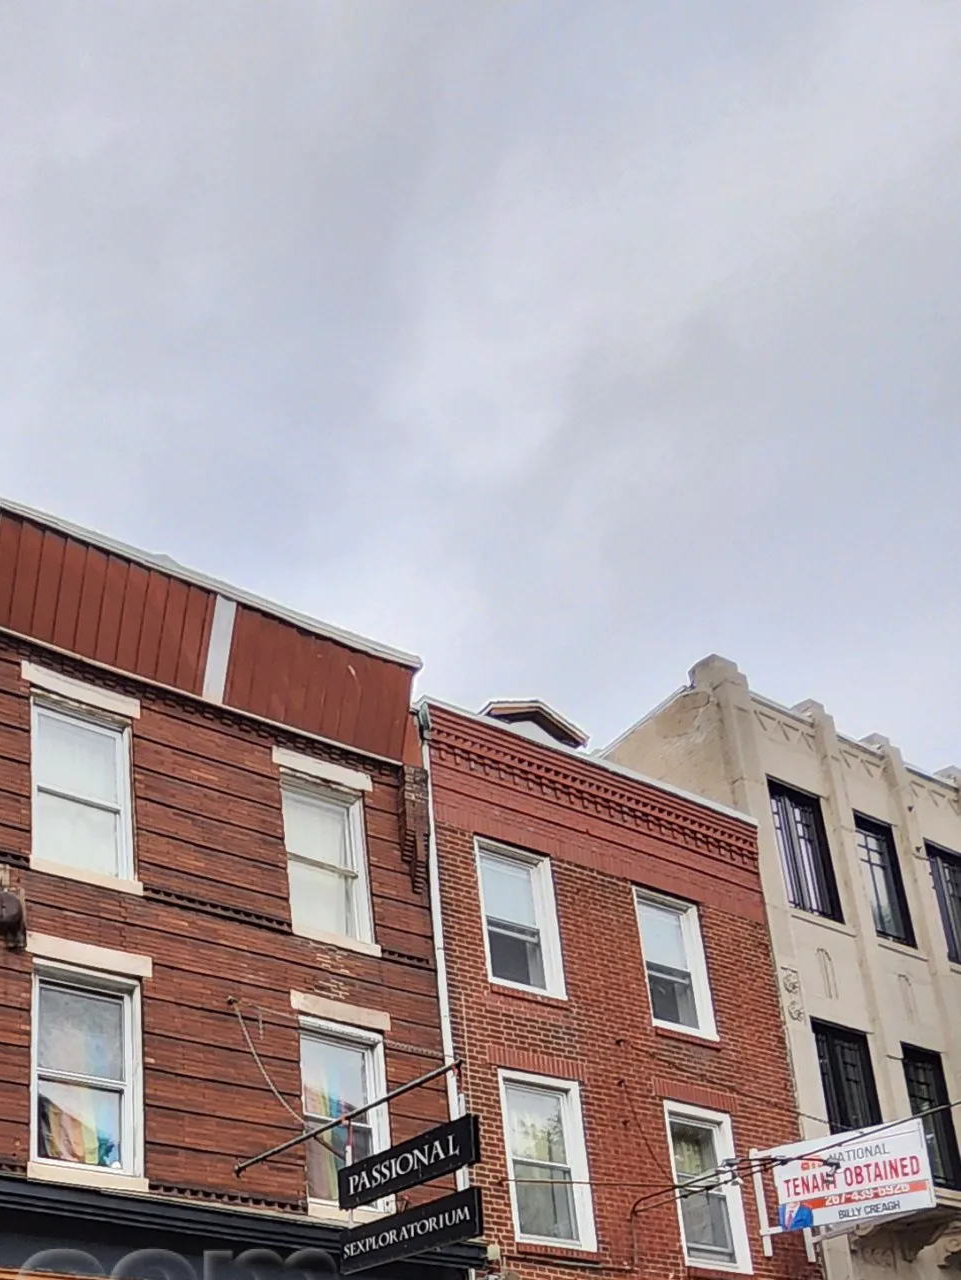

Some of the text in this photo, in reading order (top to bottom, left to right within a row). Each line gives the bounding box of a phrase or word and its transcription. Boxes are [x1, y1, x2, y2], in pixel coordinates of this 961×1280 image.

[348, 1136, 460, 1195] PASSIONAL
[783, 1169, 838, 1198] TENANT
[843, 1155, 921, 1187] OBTAINED
[829, 1143, 890, 1164] NATIONAL
[342, 1205, 471, 1260] SEXPLORATORIUM
